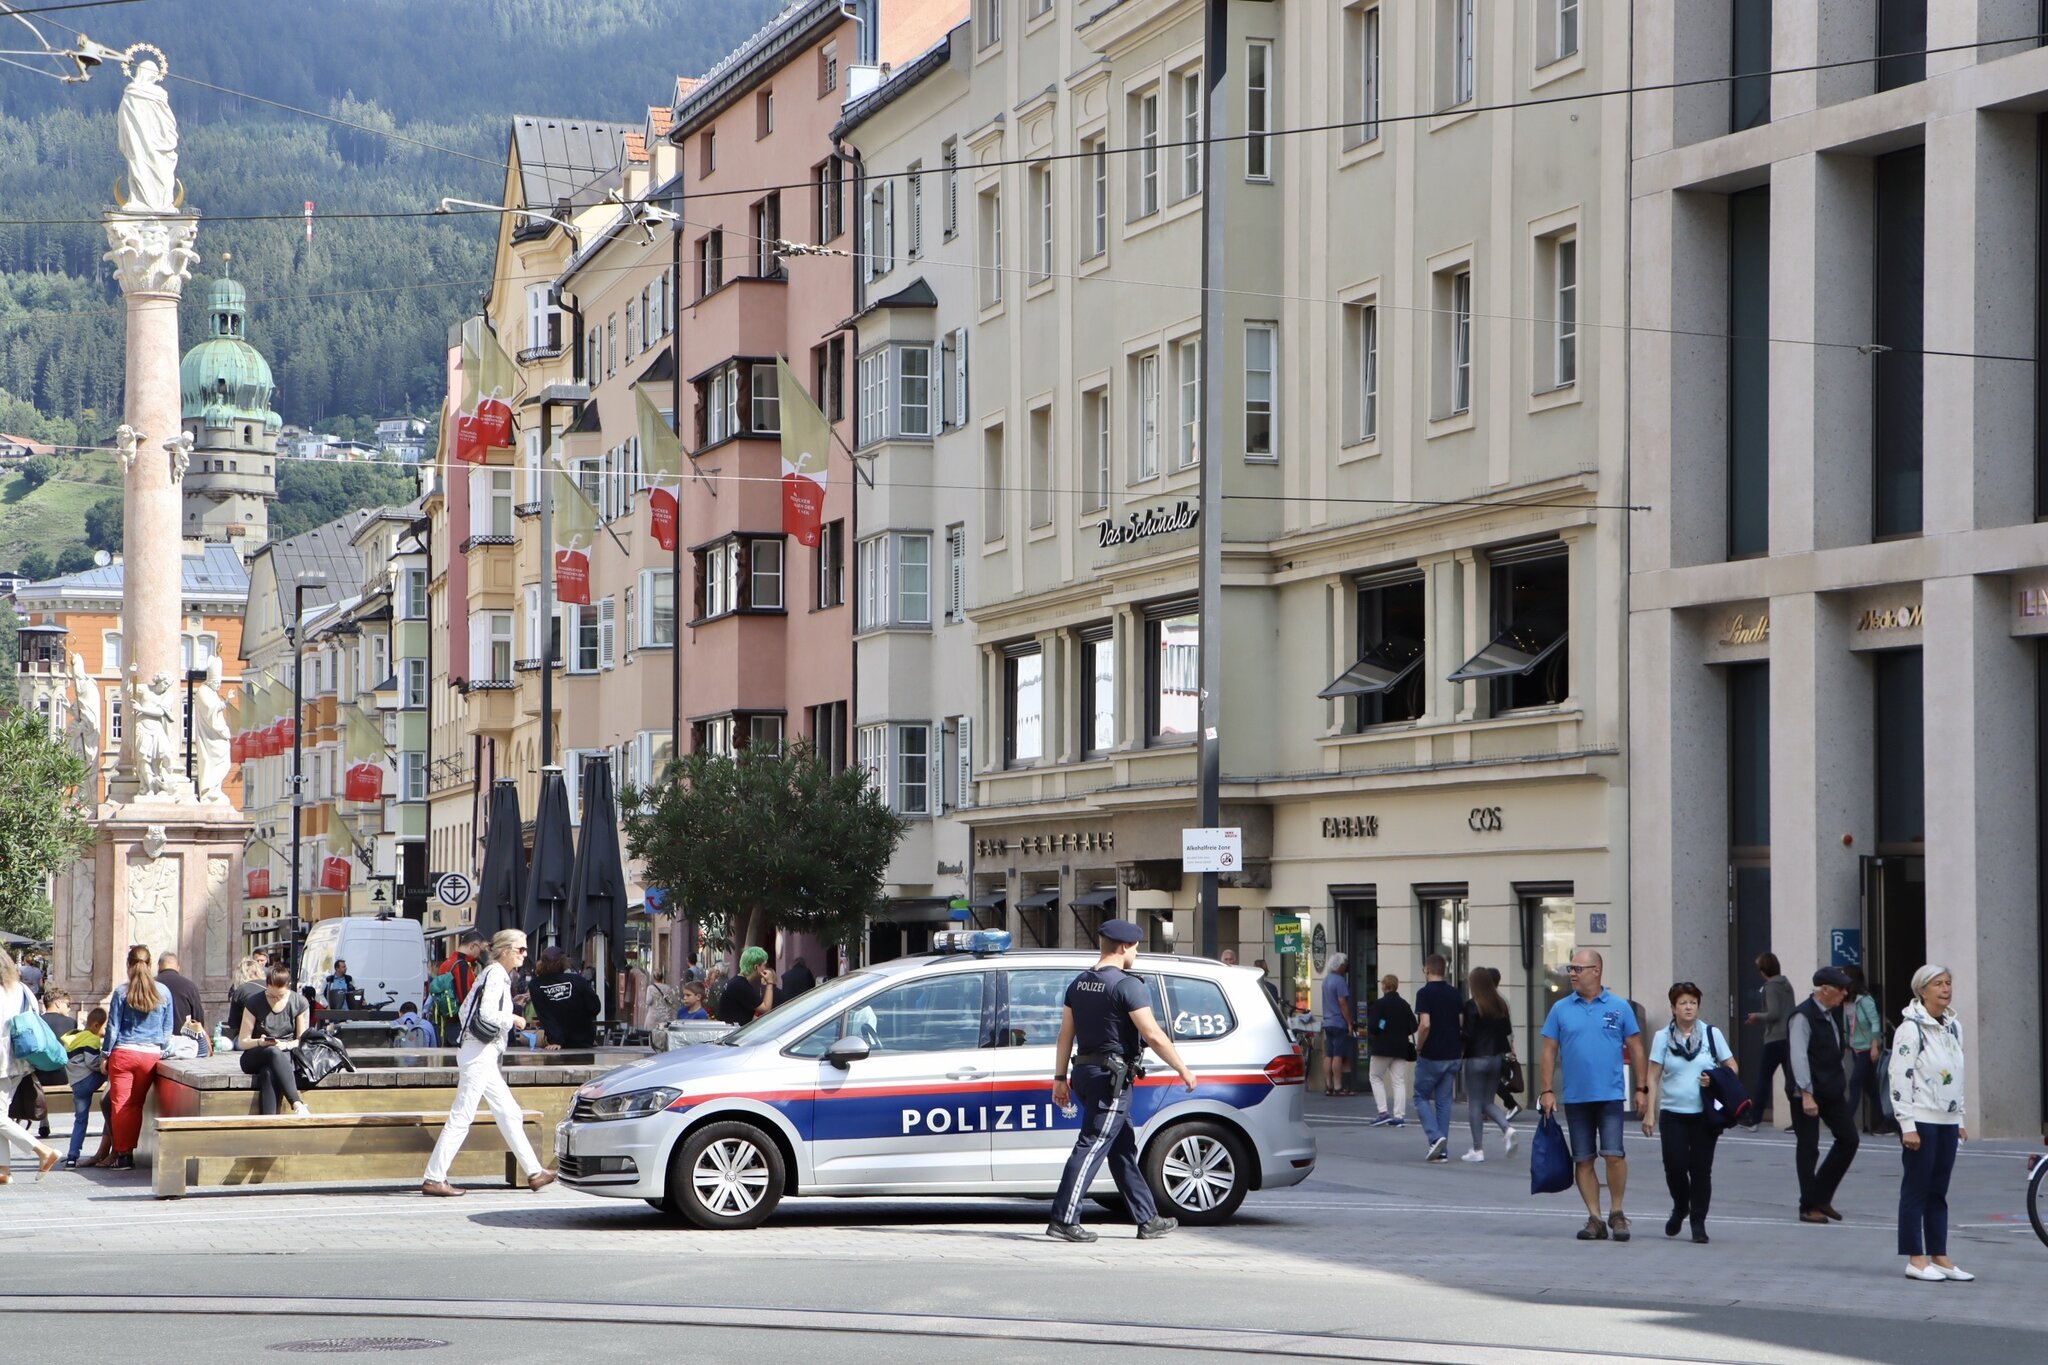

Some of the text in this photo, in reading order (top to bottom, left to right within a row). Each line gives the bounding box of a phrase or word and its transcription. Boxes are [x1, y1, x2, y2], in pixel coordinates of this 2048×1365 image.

[1097, 501, 1200, 547] Das Schindler
[1857, 610, 1900, 631] Media
[1320, 815, 1379, 838] TABAK
[1468, 807, 1503, 831] COS
[977, 832, 1114, 857] BAR CENTRALE
[1277, 924, 1299, 933] Jackpot
[1834, 936, 1844, 951] P
[1077, 981, 1106, 993] POLIZEI
[1190, 1014, 1227, 1036] 133
[902, 1103, 1053, 1134] POLIZEI
